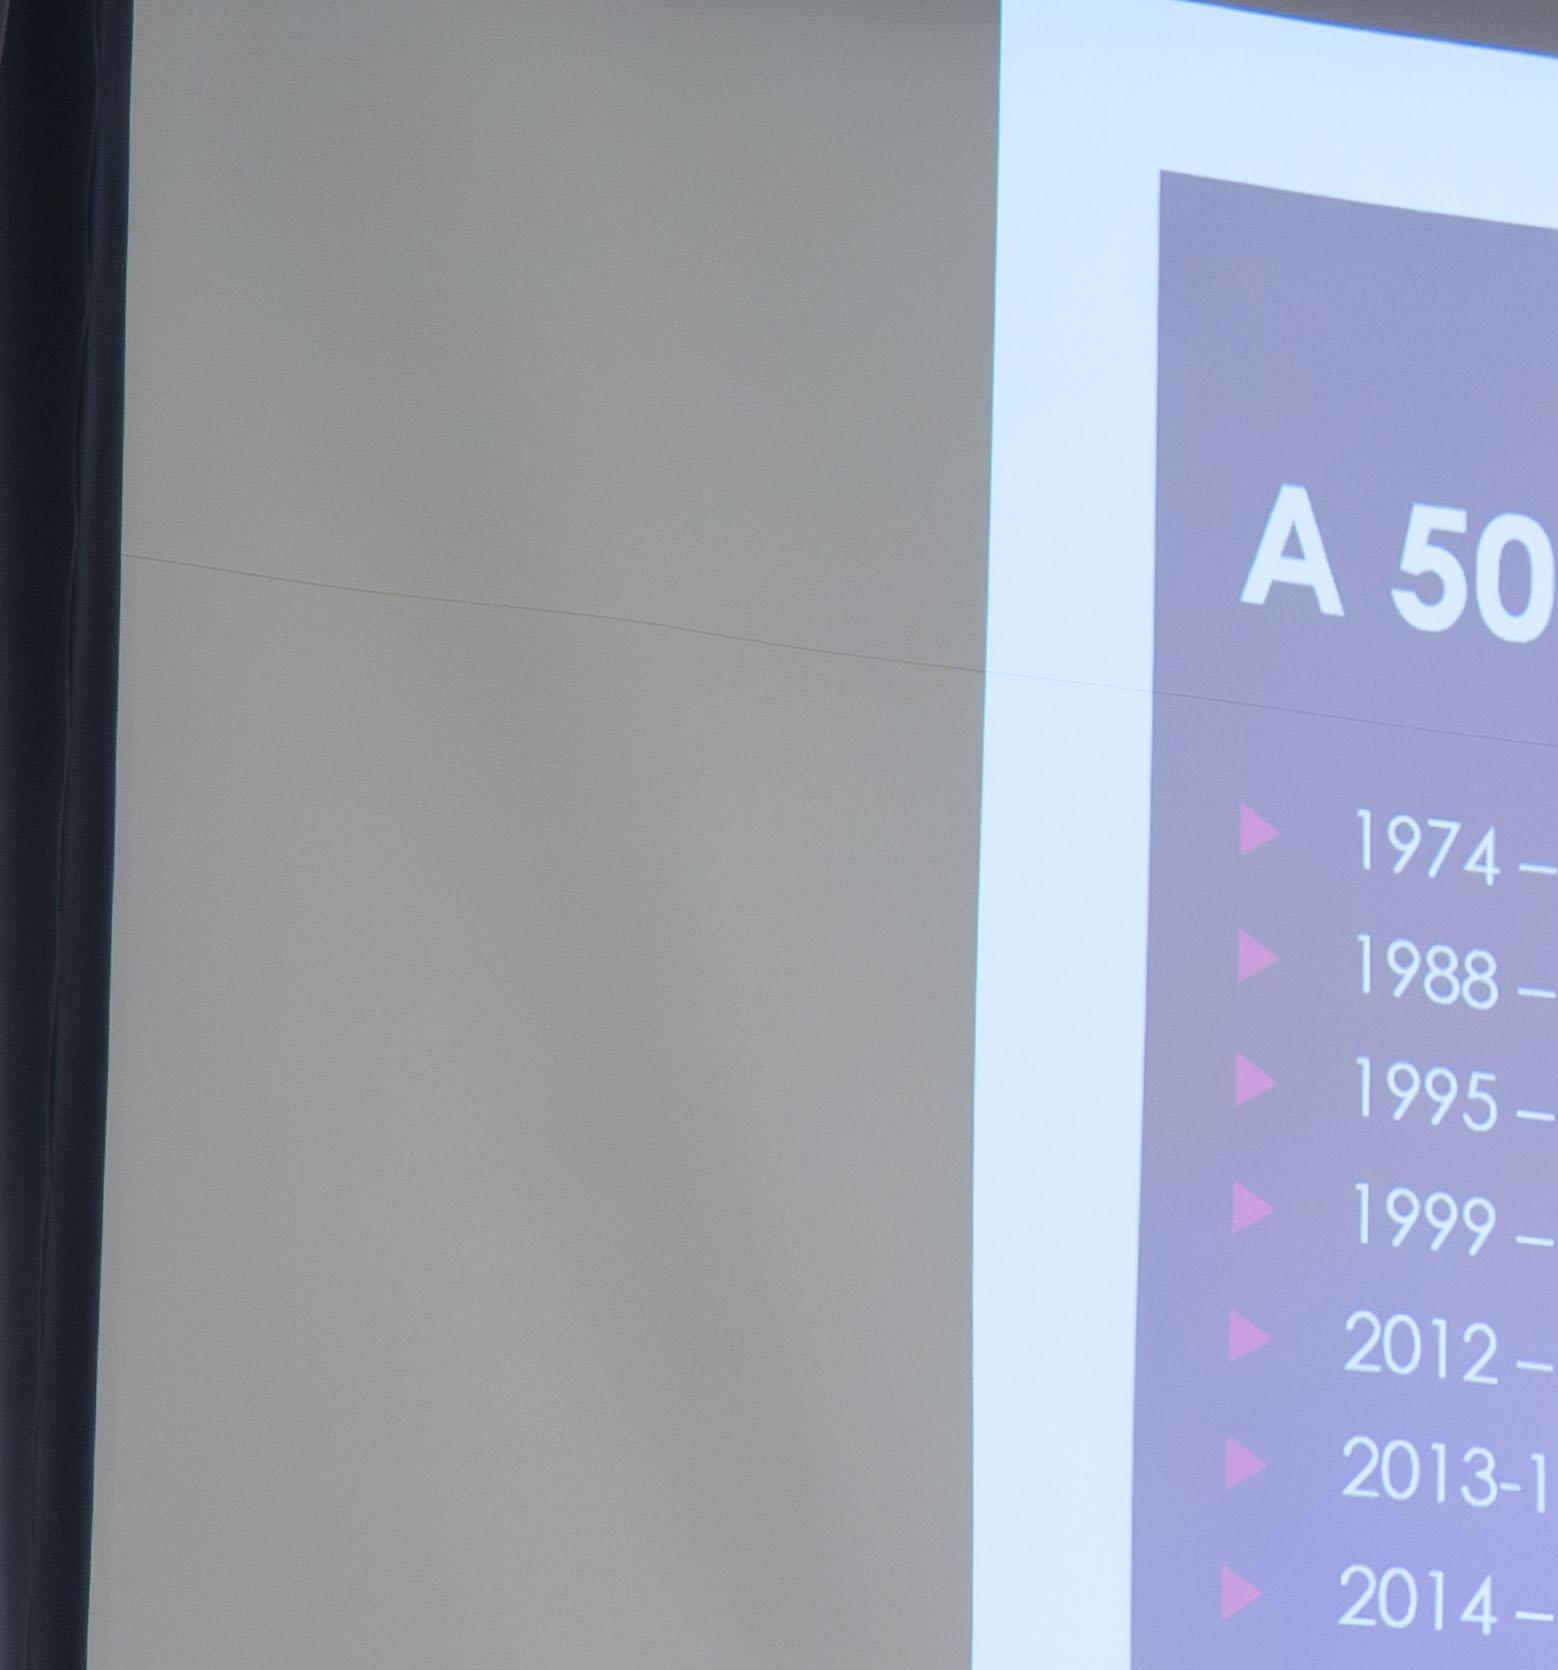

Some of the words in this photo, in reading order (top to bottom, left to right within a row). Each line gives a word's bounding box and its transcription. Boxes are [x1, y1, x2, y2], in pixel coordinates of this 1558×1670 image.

[1239, 482, 1346, 618] A
[1356, 808, 1501, 887] 1974
[1356, 933, 1499, 1011] 1988
[1355, 1055, 1498, 1132] 1995
[1354, 1182, 1497, 1257] 1999
[1343, 1309, 1499, 1385] 2012
[1337, 1564, 1499, 1636] 2014
